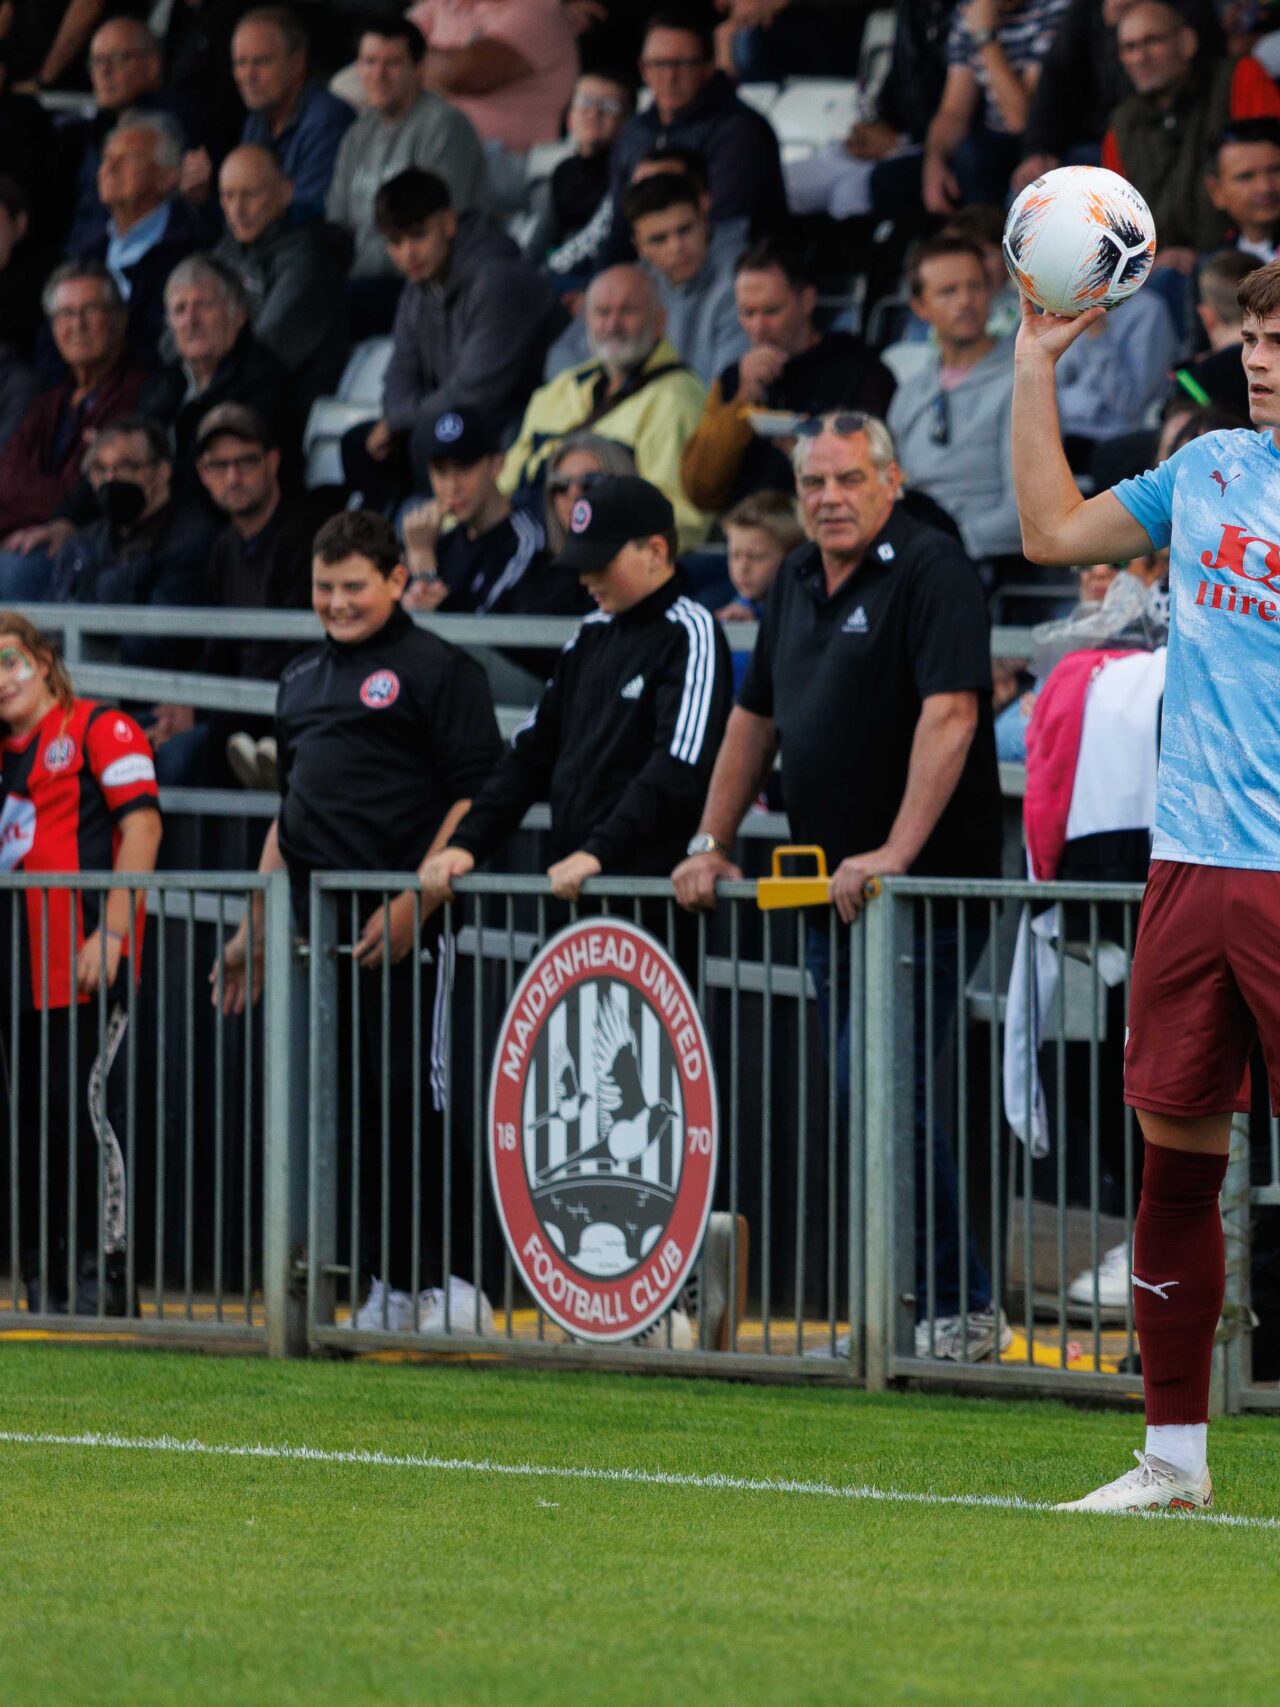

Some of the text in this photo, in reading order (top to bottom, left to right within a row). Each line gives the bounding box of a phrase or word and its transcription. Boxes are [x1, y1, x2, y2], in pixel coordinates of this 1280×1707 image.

[502, 934, 702, 1084] MAIDENHEAD UNITED
[496, 1122, 713, 1155] 18 70
[523, 1232, 683, 1326] FOOTBALL CLUB
